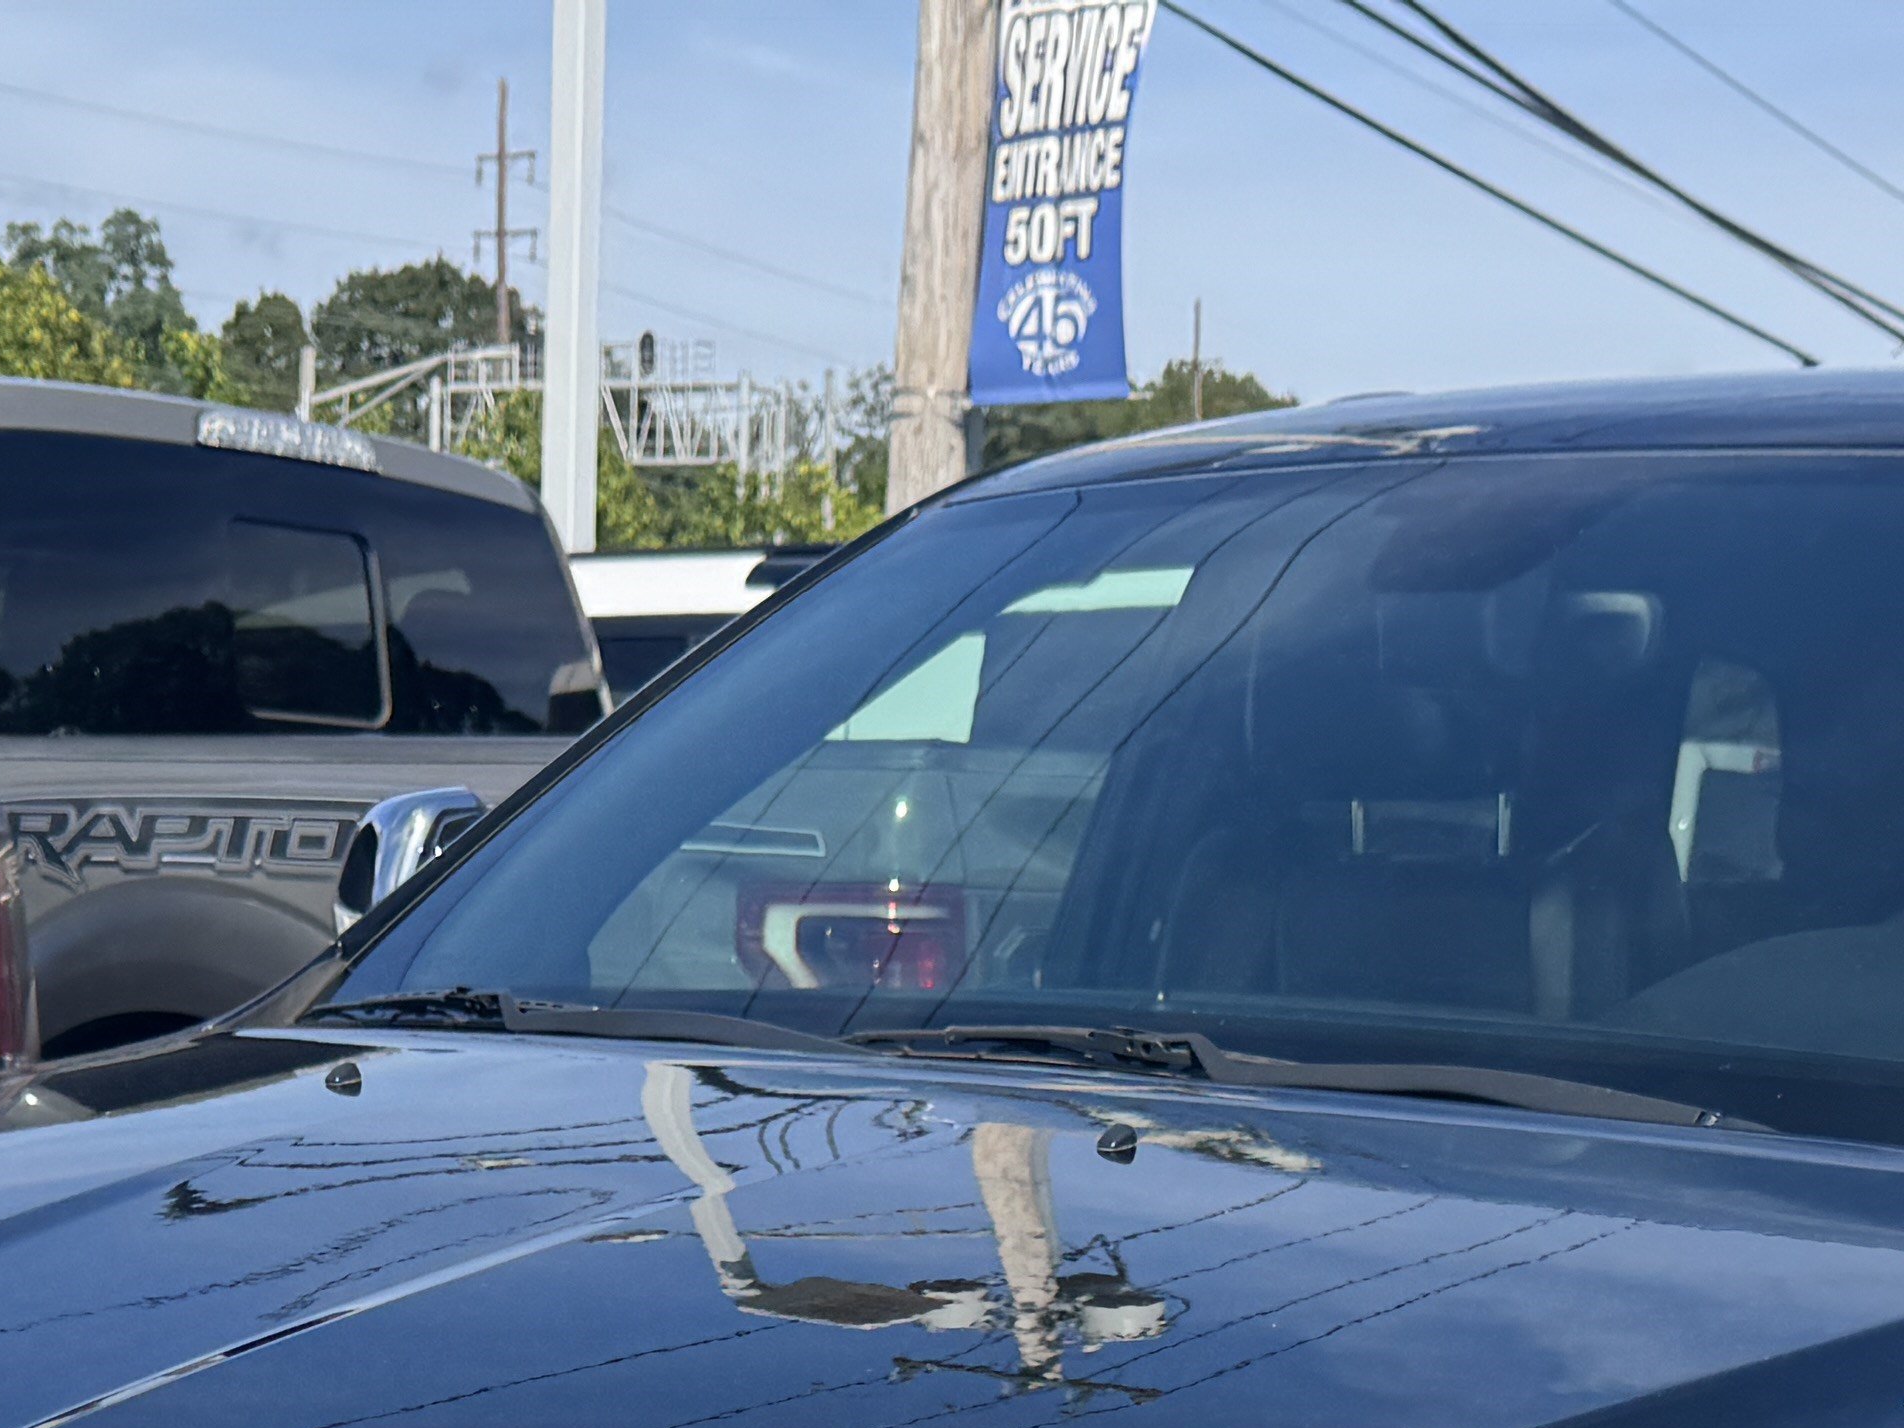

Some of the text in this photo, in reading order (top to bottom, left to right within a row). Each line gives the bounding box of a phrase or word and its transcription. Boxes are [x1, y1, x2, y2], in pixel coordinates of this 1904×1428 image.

[1000, 4, 1143, 140] SERVICE
[992, 126, 1125, 202] ENTRANCE
[1003, 196, 1098, 266] 50FT
[5, 804, 360, 895] RAPTO
